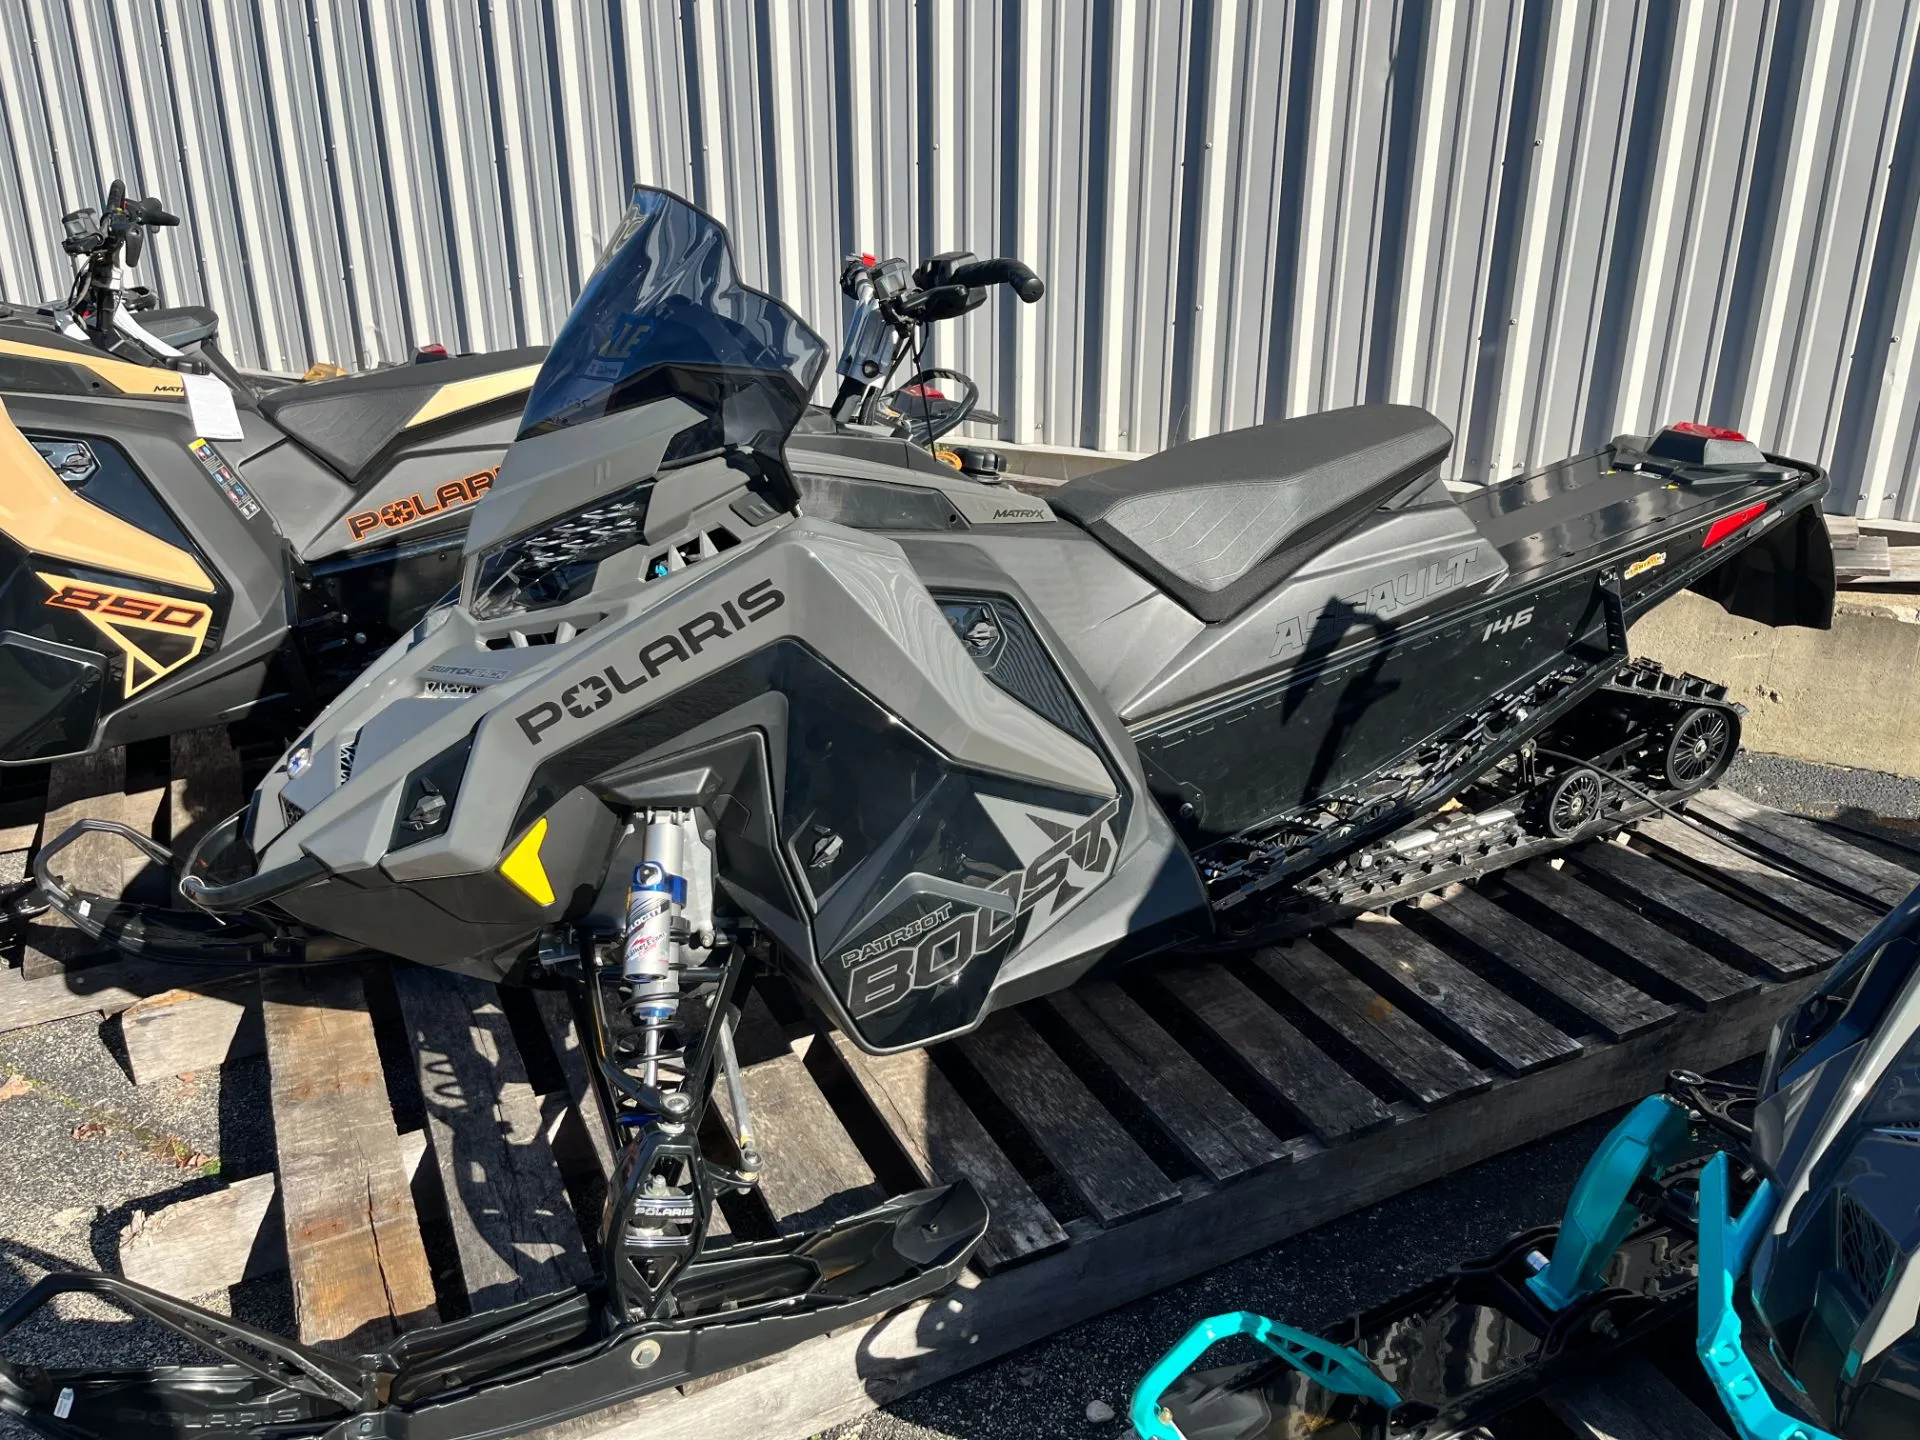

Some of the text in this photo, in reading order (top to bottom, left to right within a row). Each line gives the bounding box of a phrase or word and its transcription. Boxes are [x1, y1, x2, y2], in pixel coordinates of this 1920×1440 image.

[993, 509, 1045, 519] MATRYX
[44, 586, 205, 629] 850
[1482, 605, 1535, 643] 146
[515, 578, 786, 746] POLARIS
[841, 901, 952, 968] PATRIOT
[634, 1207, 694, 1217] POLARIS
